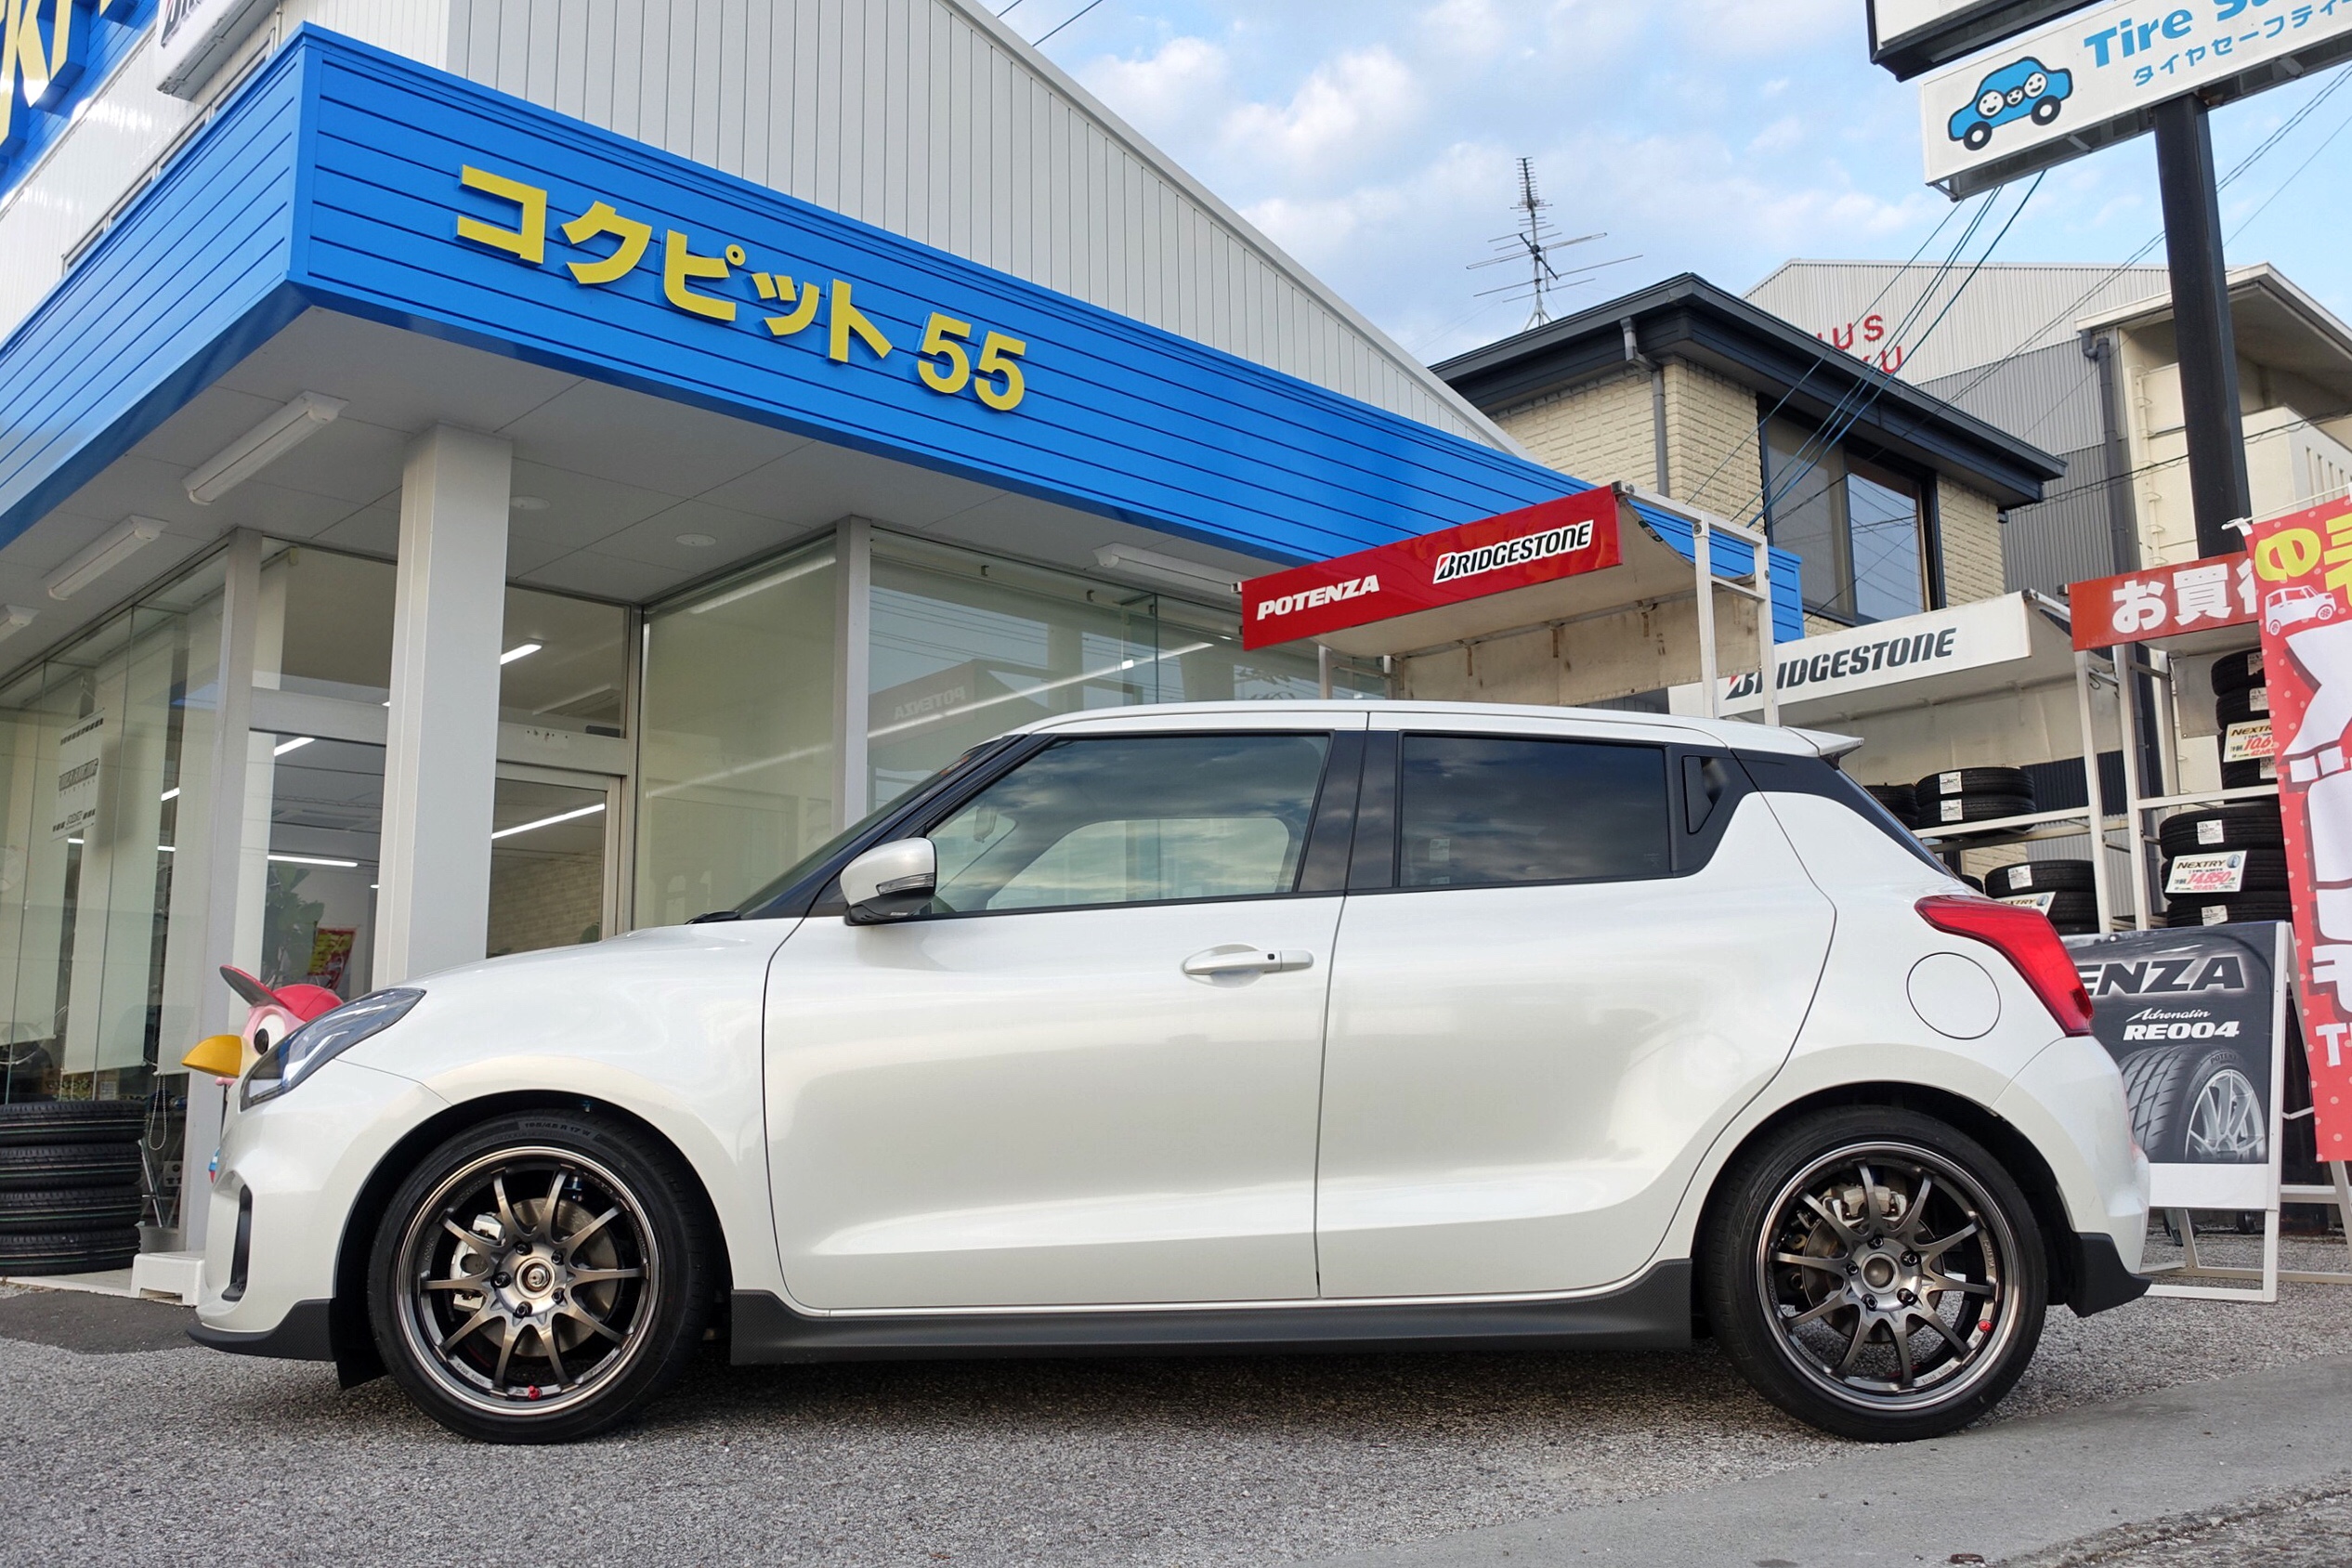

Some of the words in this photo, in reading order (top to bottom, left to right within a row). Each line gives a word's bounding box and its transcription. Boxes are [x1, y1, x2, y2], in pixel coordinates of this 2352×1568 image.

[2084, 8, 2193, 68] Tire
[456, 164, 894, 363] コクピット
[916, 311, 1026, 412] 55
[1256, 574, 1380, 621] POTENZA
[1433, 520, 1594, 584] BRIDGESTONE
[2176, 859, 2226, 869] NEXTRY
[2123, 1020, 2241, 1041] RE004
[2125, 1007, 2212, 1023] Adrenalin
